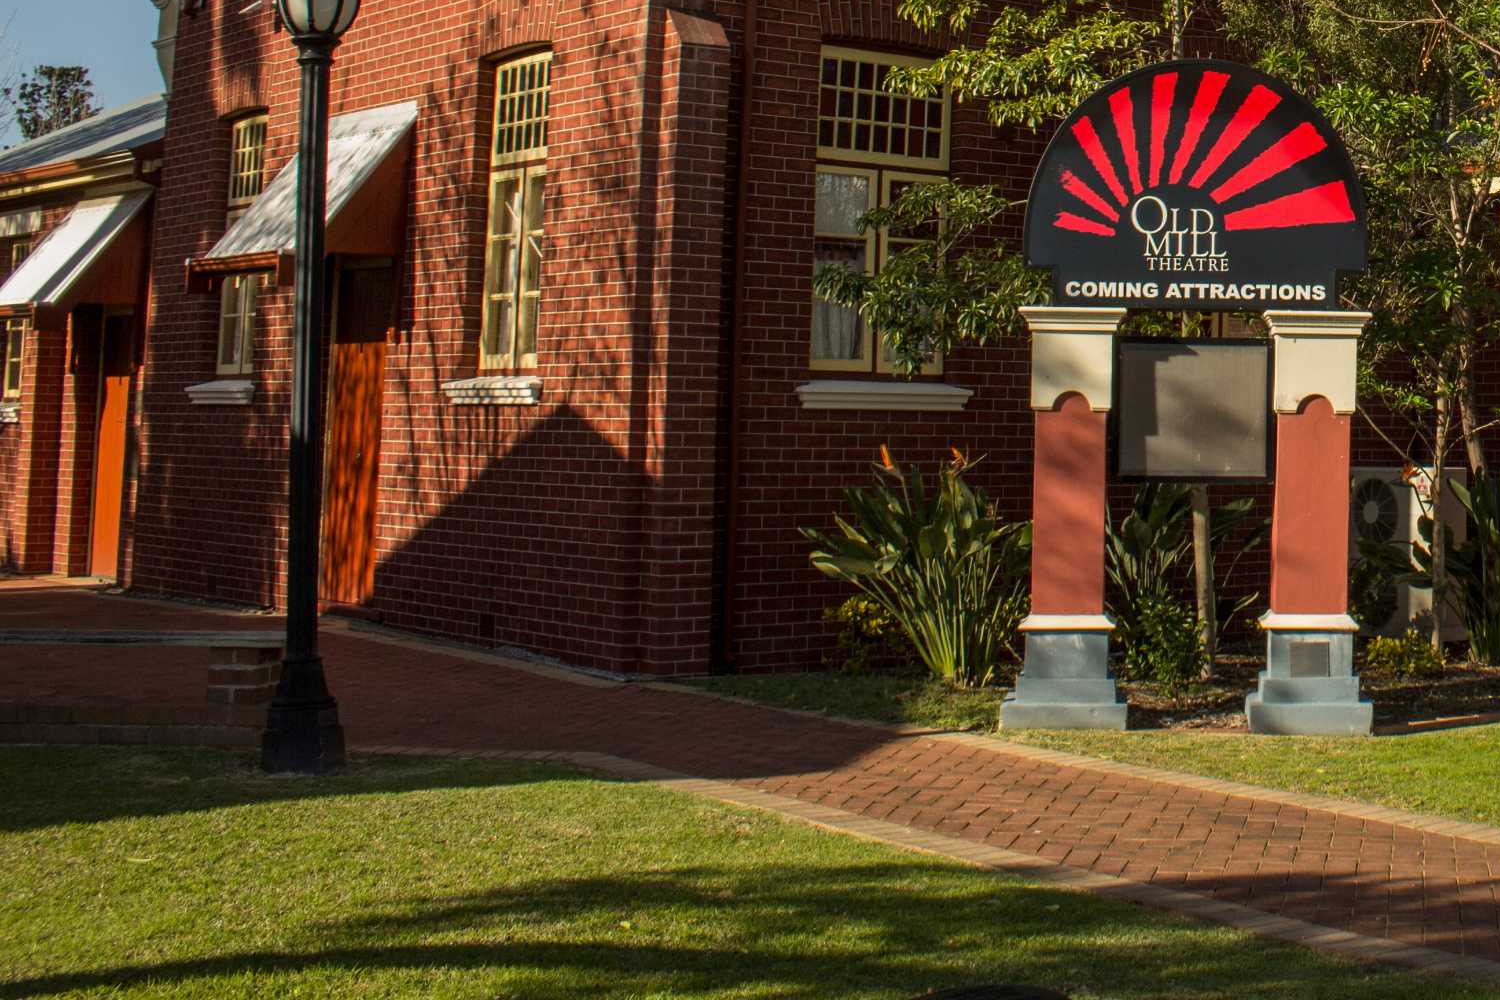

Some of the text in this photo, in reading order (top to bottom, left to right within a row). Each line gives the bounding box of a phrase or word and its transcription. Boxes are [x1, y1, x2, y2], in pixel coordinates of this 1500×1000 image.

[1131, 195, 1214, 234] OLD
[1143, 231, 1227, 257] MILL
[1146, 257, 1230, 272] THEATRE
[1065, 281, 1327, 300] COMING ATTRACTIONS
